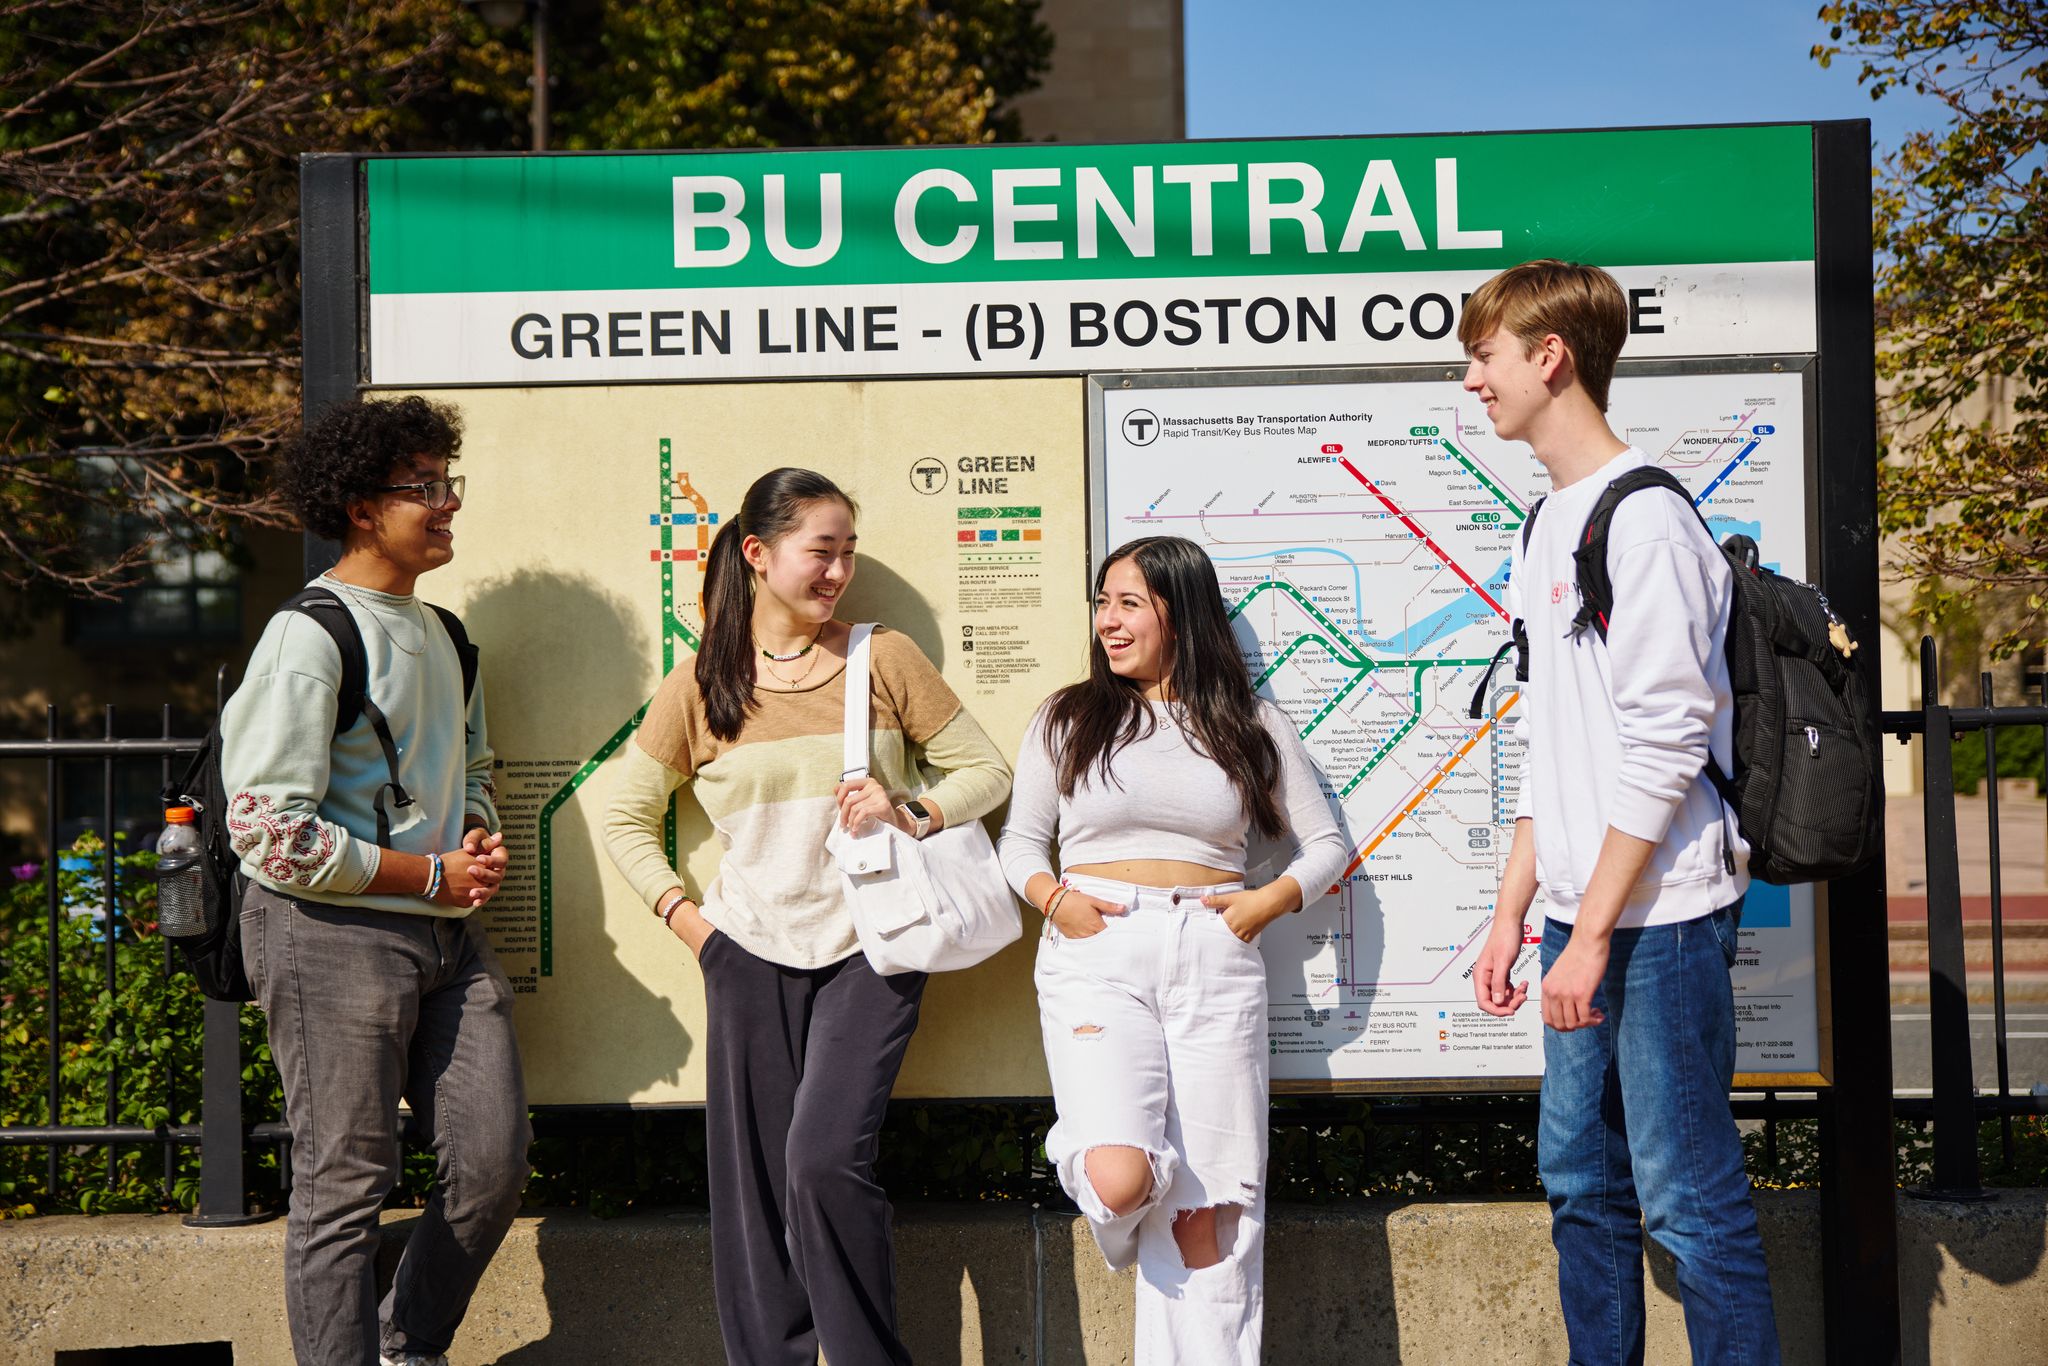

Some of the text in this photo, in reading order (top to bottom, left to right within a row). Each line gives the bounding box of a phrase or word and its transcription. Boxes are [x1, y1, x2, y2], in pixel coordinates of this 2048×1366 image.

[672, 158, 1502, 268] BU CENTRAL
[510, 309, 731, 360] GREEN
[758, 306, 898, 354] LINE
[922, 329, 942, 338] -
[966, 303, 1045, 361] (B)
[1070, 296, 1337, 347] BOSTON
[1163, 411, 1373, 426] Massachusetts Bay Transportation Authority
[1129, 418, 1153, 440] T
[1163, 425, 1318, 439] Rapid Transit/Key Bus Routes Map
[1431, 427, 1437, 435] E
[1758, 426, 1770, 434] BL
[1367, 438, 1433, 447] MEDFORD/TUFTS
[1683, 437, 1739, 445] WONDERLAND
[1437, 454, 1446, 462] Sq
[957, 455, 1035, 473] GREEN
[1428, 469, 1461, 477] Magoun Sq
[916, 467, 941, 489] T
[958, 477, 1009, 495] LINE
[1476, 513, 1498, 522] GL D
[1714, 515, 1737, 523] Heights
[1483, 523, 1493, 531] SQ
[1439, 672, 1458, 692] Arlington
[1302, 698, 1323, 706] Village
[1397, 831, 1413, 839] Stony
[1471, 829, 1487, 837] SL4
[530, 966, 537, 975] B
